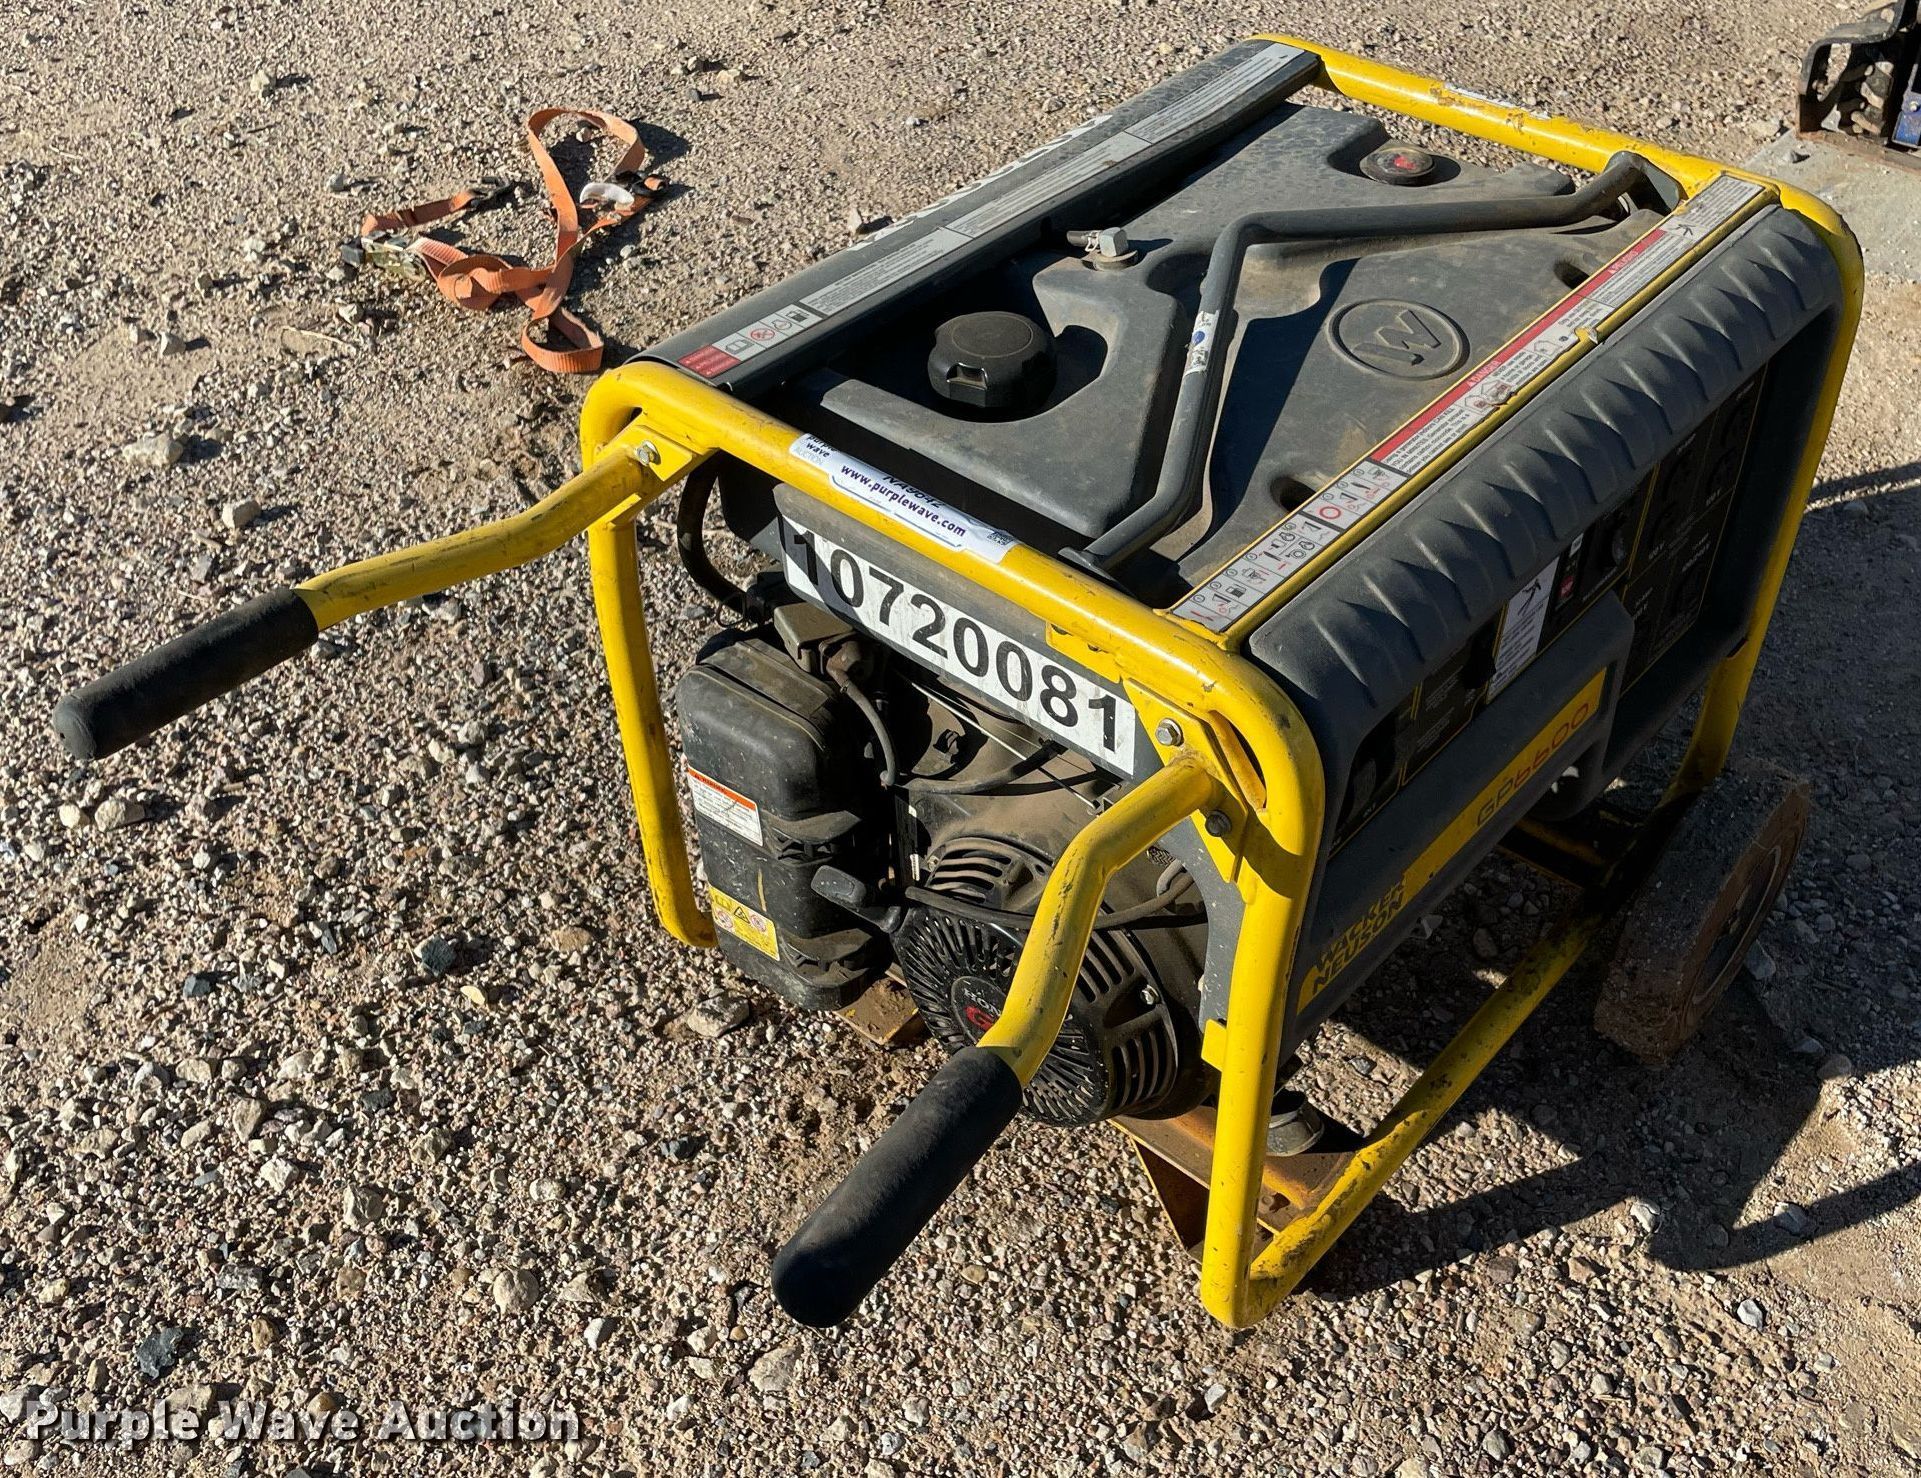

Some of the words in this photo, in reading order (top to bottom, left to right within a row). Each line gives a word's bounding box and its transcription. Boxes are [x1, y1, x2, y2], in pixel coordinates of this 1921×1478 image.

[806, 443, 830, 457] wave
[841, 465, 966, 537] www.purplewave.com
[794, 530, 1117, 752] 10720081
[1478, 703, 1589, 827] GP6600
[1312, 889, 1405, 996] NEUSON
